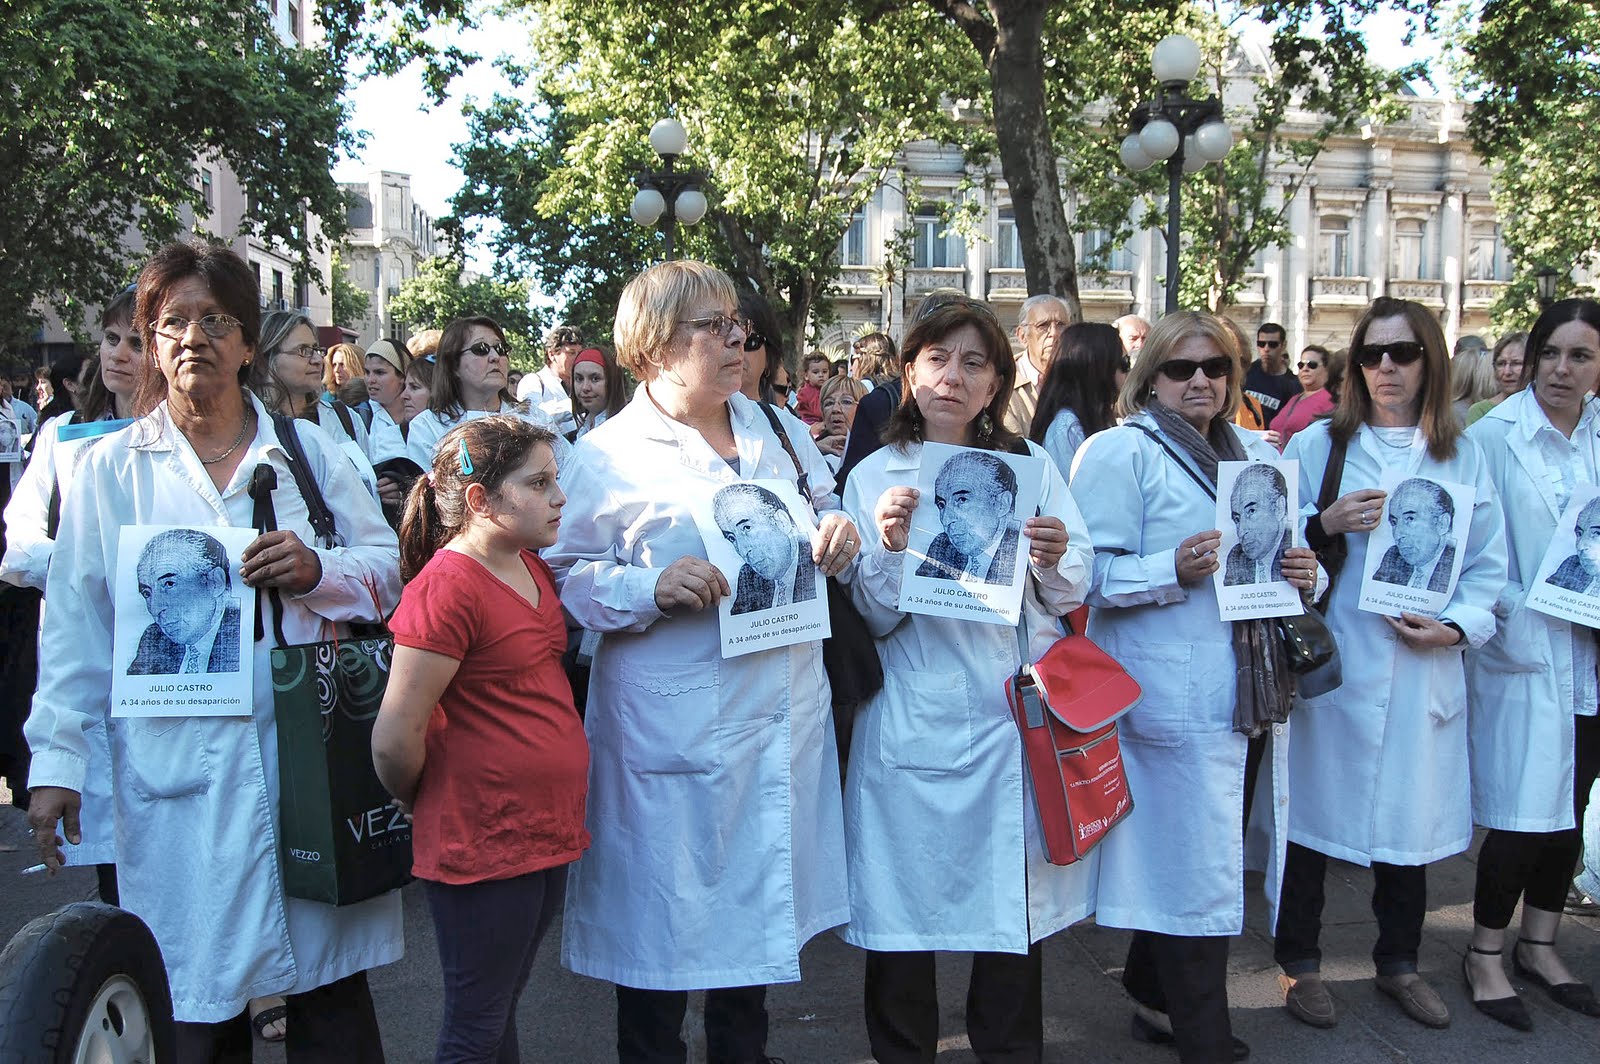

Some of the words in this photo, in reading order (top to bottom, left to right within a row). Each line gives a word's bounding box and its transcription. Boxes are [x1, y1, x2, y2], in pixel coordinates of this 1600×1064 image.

[933, 588, 955, 596] JULIO
[957, 590, 988, 600] CASTRO
[1404, 594, 1429, 604] CASTRO
[1557, 596, 1576, 604] JULIO
[1578, 601, 1600, 610] CASTR
[965, 604, 1009, 615] desaparición
[750, 619, 770, 628] JULIO
[772, 614, 798, 624] CASTRO
[781, 622, 820, 634] desaparición
[188, 697, 240, 706] desaparición
[347, 804, 408, 843] VEZ
[290, 848, 320, 861] VEZZO
